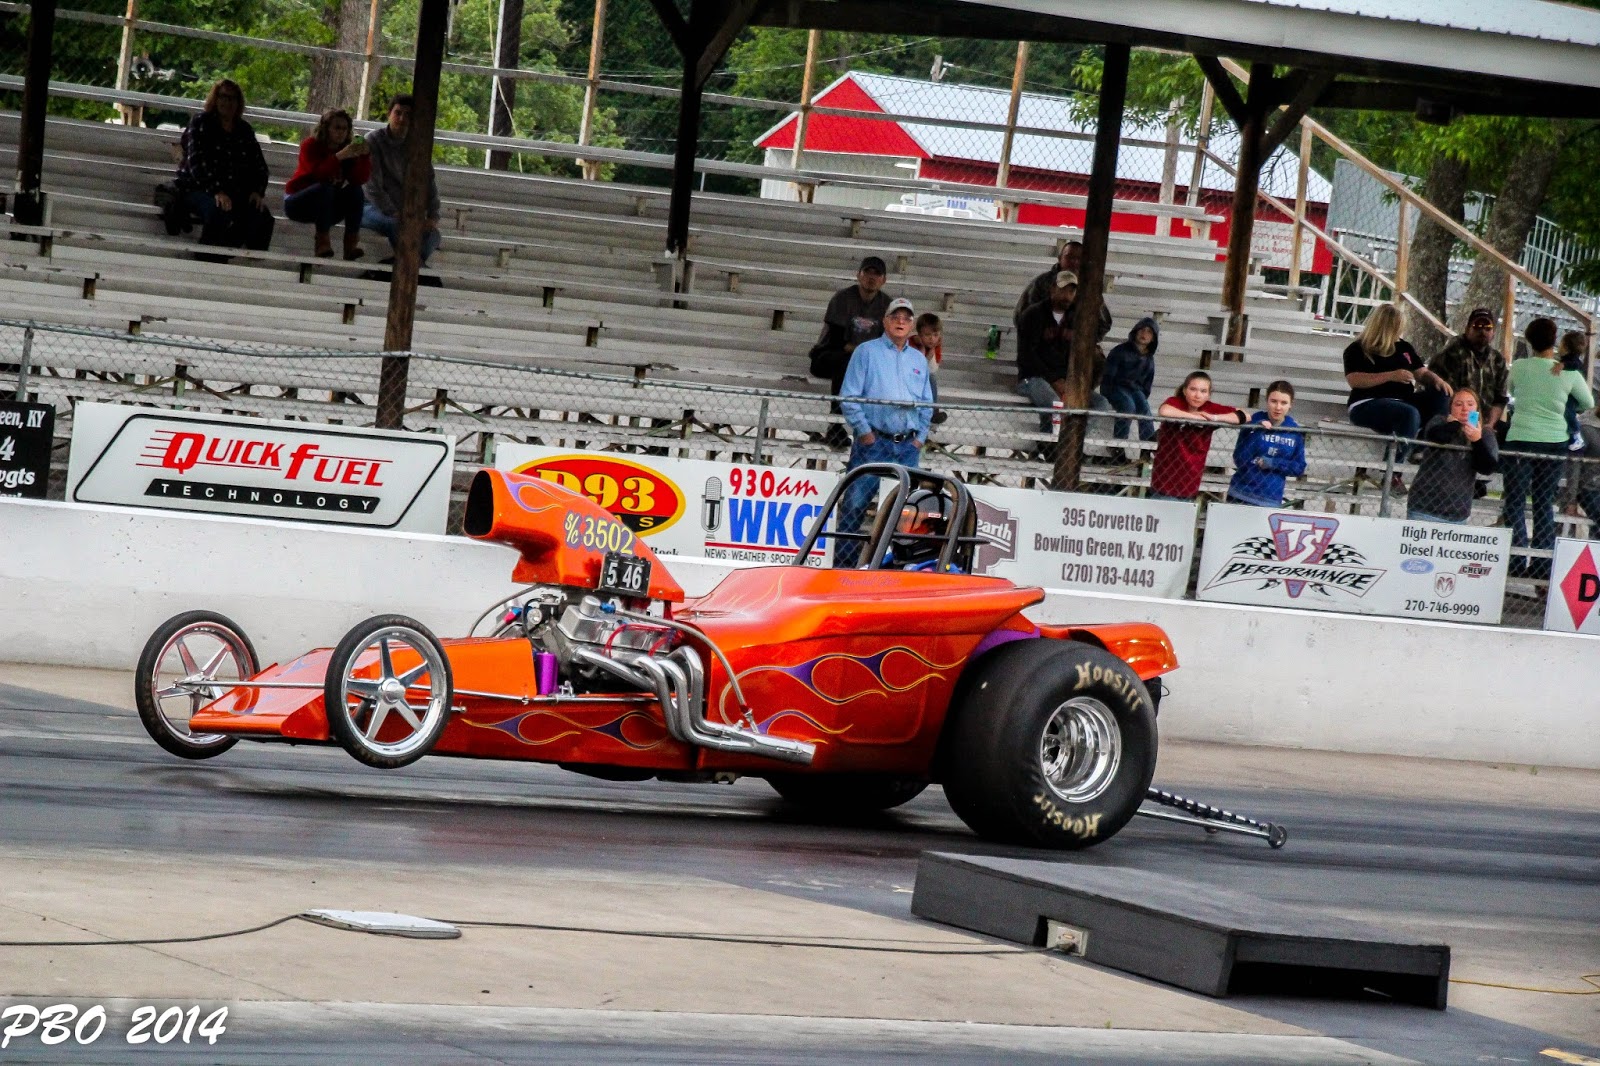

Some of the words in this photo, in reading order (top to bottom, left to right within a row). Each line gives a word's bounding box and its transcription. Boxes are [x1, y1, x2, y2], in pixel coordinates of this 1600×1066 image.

[26, 409, 46, 428] KY
[161, 432, 287, 474] QUICK
[161, 483, 372, 511] TECHNOLOGY
[977, 518, 1012, 541] earth
[1062, 507, 1086, 528] 395
[1088, 510, 1143, 532] Corvette
[1145, 514, 1160, 533] Dr
[582, 517, 634, 555] 3502
[1402, 525, 1428, 542] High
[1431, 528, 1499, 546] Performance
[704, 548, 727, 560] NEWS
[731, 550, 766, 563] WEATHER
[770, 553, 796, 566] SPORT
[804, 555, 822, 567] NFO
[1034, 533, 1083, 557] Bowling
[1086, 537, 1125, 560] Green,
[1127, 541, 1145, 561] Ky.
[1147, 543, 1184, 563] 42101
[1400, 543, 1434, 557] Diesel
[1435, 546, 1500, 563] Accessories
[1061, 562, 1094, 584] (270)
[1096, 565, 1155, 588] 783-4443
[1216, 562, 1377, 590] PERFORMANCE
[1462, 565, 1488, 576] CHEVY
[1404, 599, 1480, 616] 270-746-9999
